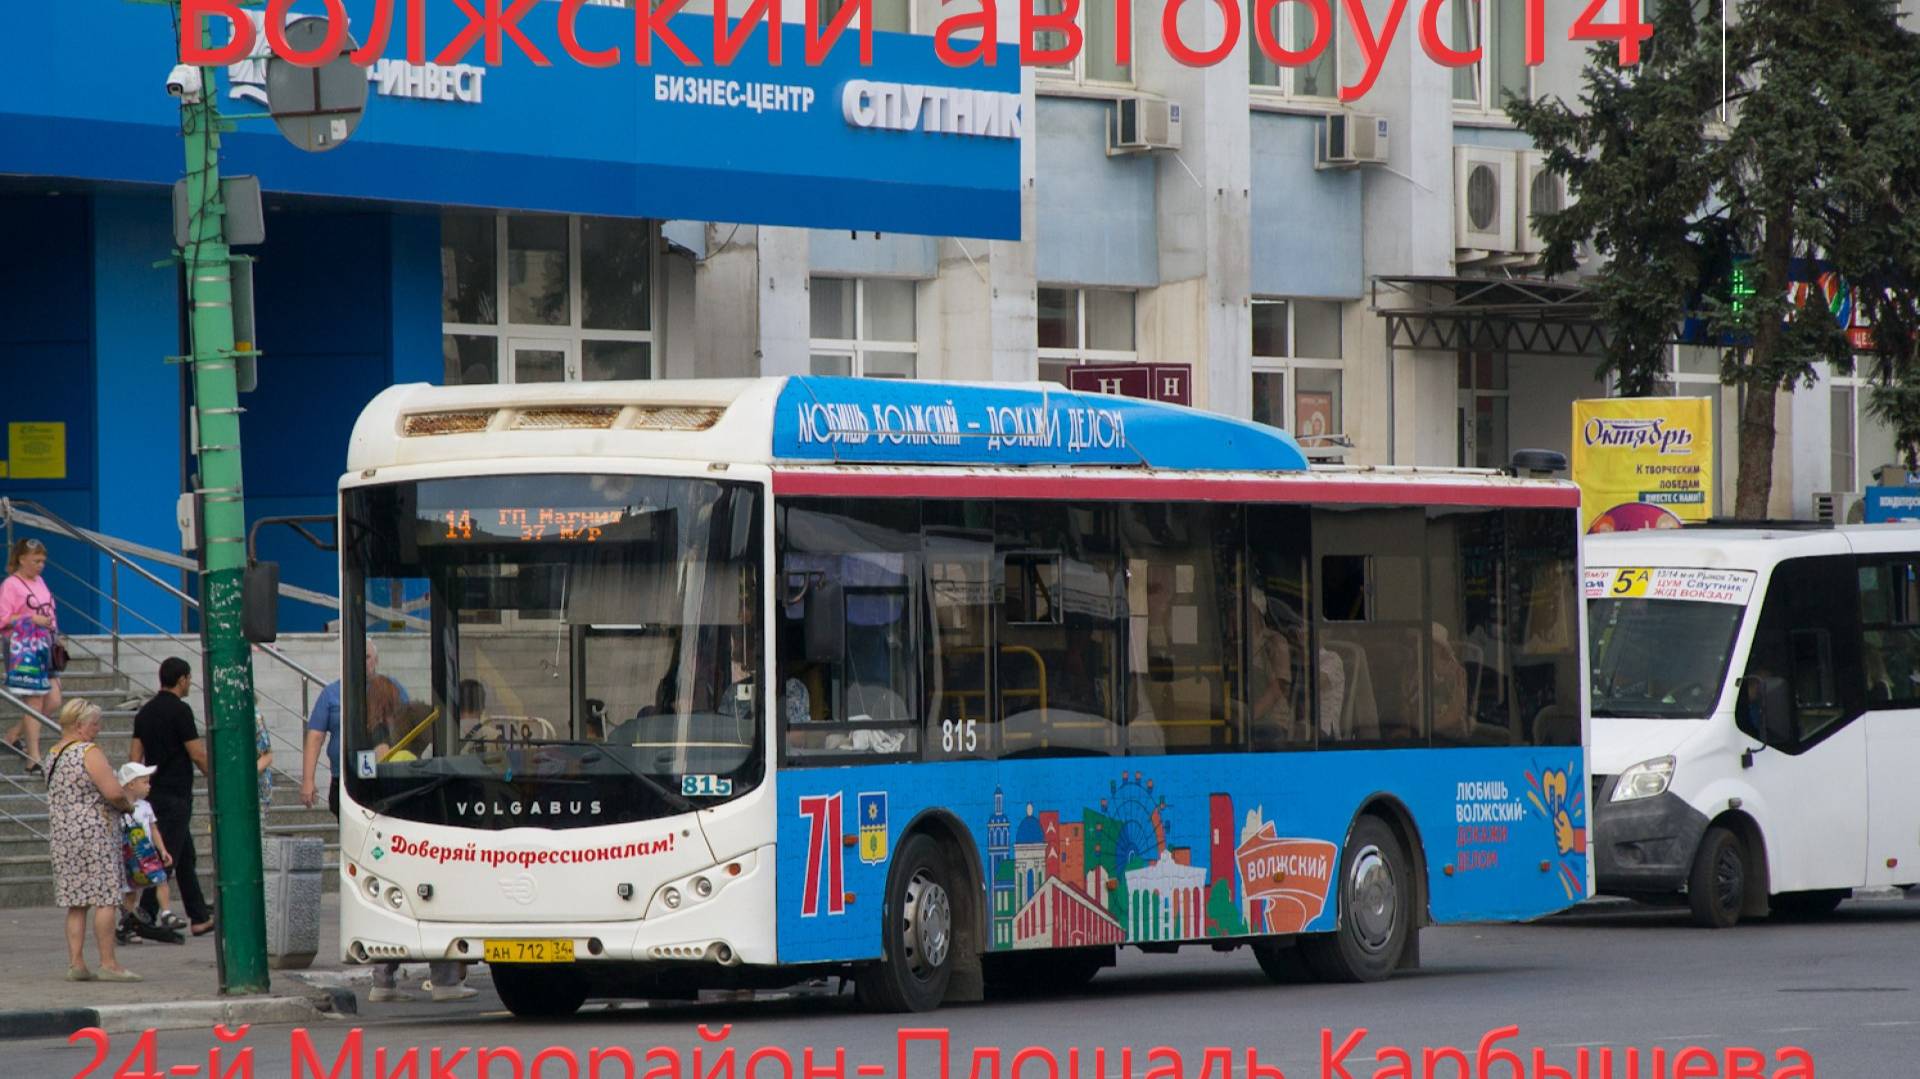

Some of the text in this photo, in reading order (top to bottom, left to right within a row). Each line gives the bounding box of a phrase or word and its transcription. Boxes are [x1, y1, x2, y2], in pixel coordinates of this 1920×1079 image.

[654, 74, 815, 114] БИЗНЕС-ЦЕНТР
[842, 79, 1021, 138] СПУТНИК
[872, 400, 961, 445] ВОЛЖСКИЙ
[986, 406, 1062, 451] ДОКАЖИ
[1068, 408, 1126, 452] ДЕЛОМ
[1585, 417, 1693, 453] Октябрь
[1636, 464, 1642, 474] К
[445, 509, 472, 539] 14
[521, 524, 545, 540] 37
[1657, 579, 1744, 592] ЦУМ Спутник
[1680, 589, 1734, 600] ВОКЗАЛ
[942, 719, 977, 752] 815
[682, 776, 732, 795] 815
[1456, 781, 1508, 801] ЛЮБИШЬ
[457, 801, 601, 815] VOLGABUS
[1456, 825, 1508, 848] ДОКАЖИ
[391, 833, 675, 868] Доверяй профессионалам!
[799, 790, 845, 917] 71
[1456, 850, 1498, 872] ДЕЛОМ
[1247, 854, 1327, 882] ВОЛЖСКИЙ
[517, 943, 544, 959] 712
[553, 942, 568, 954] 34
